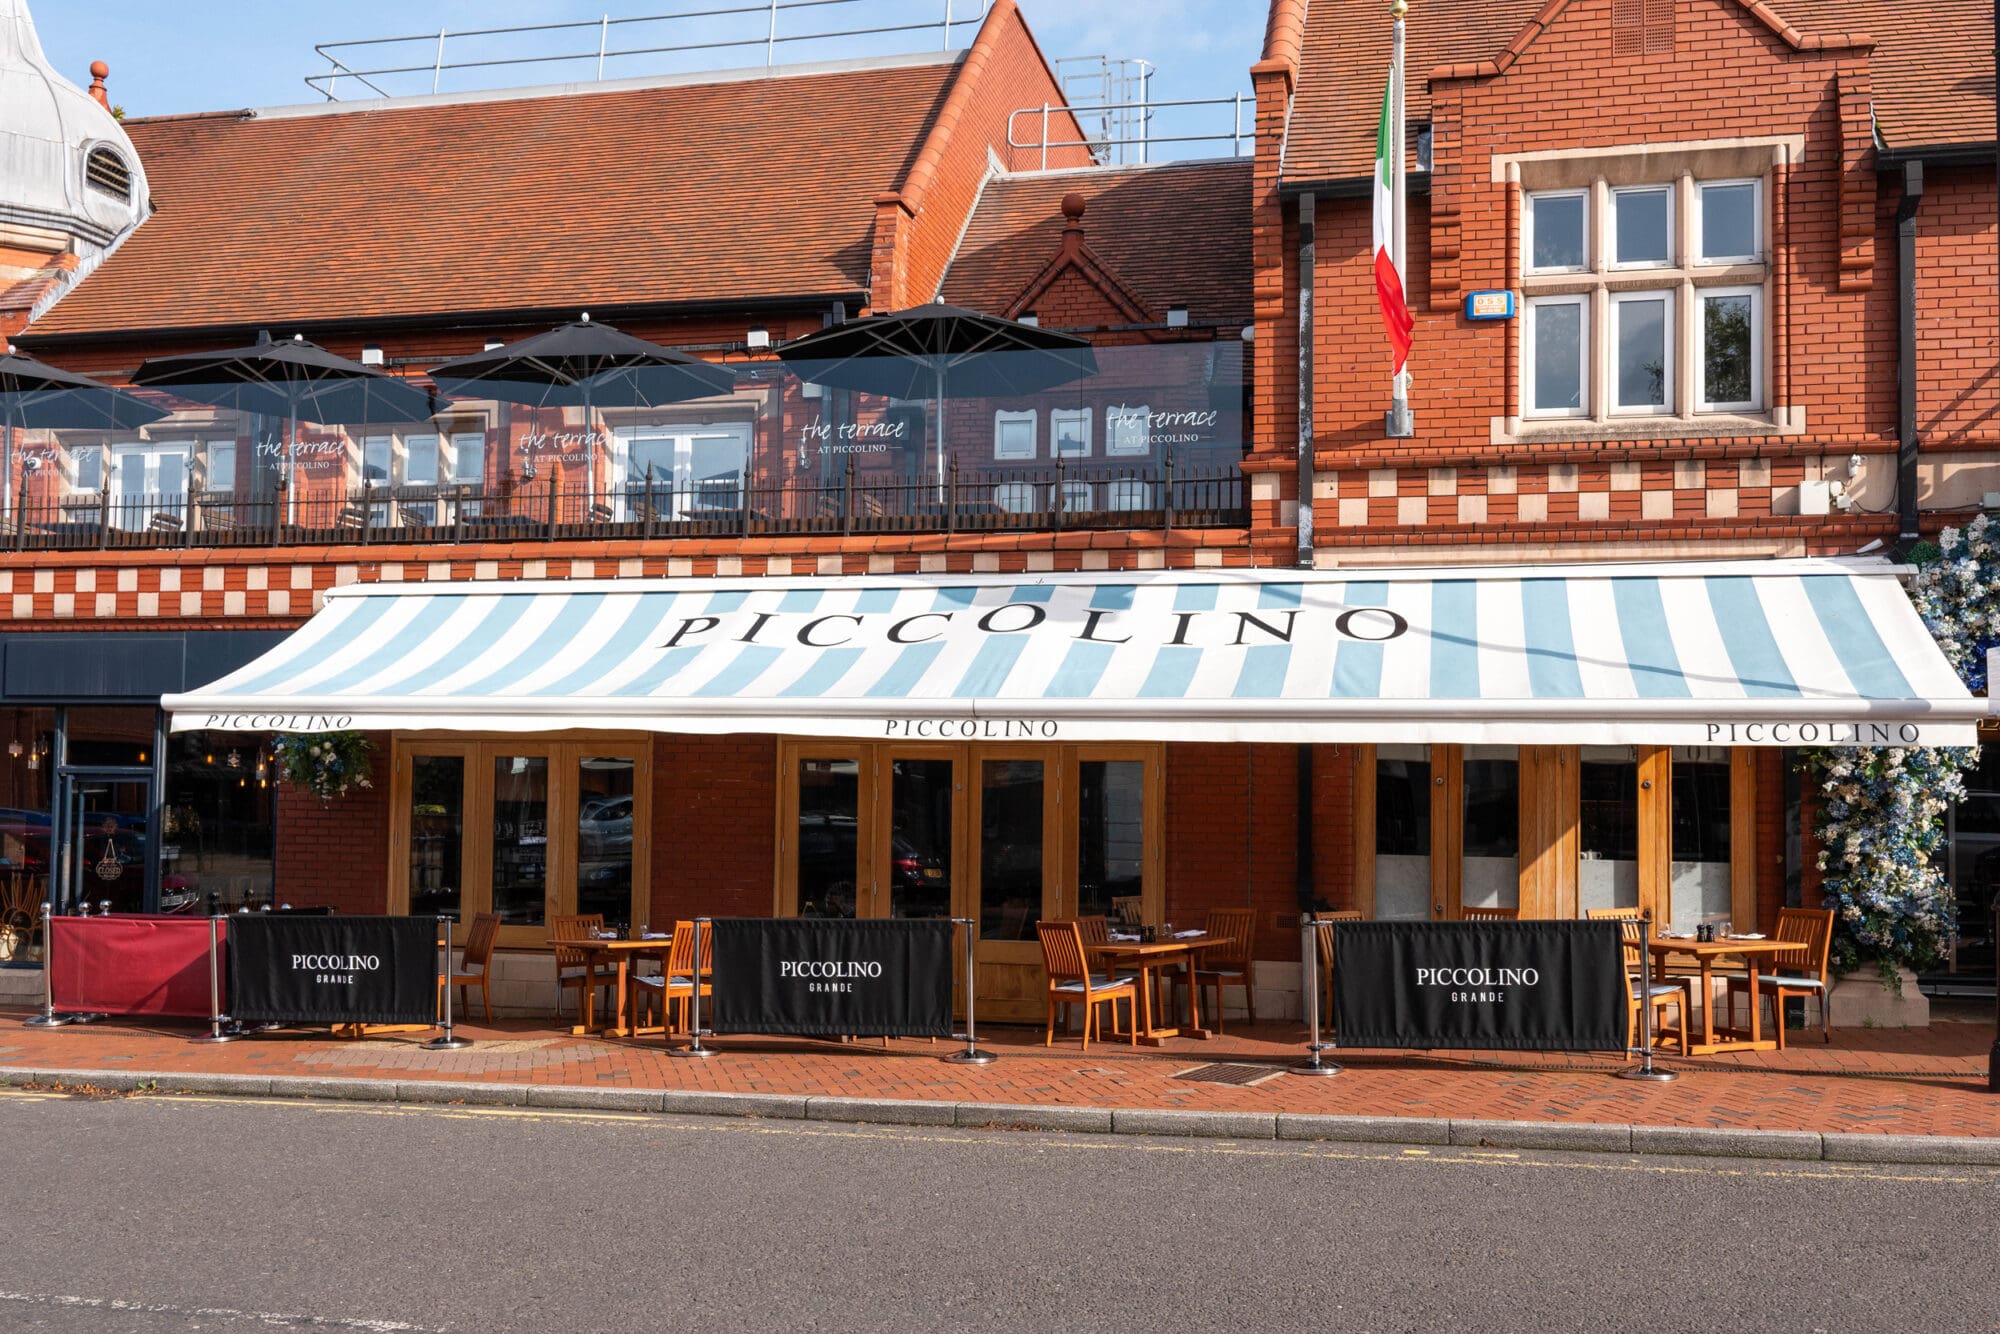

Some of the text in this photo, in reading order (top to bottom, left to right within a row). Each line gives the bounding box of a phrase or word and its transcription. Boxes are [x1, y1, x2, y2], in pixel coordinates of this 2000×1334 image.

[1107, 403, 1217, 429] the terrace
[519, 423, 614, 449] the terrac
[801, 414, 904, 444] the terrace
[256, 433, 344, 457] the terrace
[1141, 434, 1199, 443] PICCOLINO
[11, 442, 35, 465] the
[817, 444, 887, 454] AT PICCOLINO
[548, 453, 598, 462] PICCOLINO
[656, 604, 1409, 647] PICCOLINO
[204, 714, 352, 730] PICCOLINO
[885, 720, 1058, 737] PICCOLINO
[1706, 723, 1920, 742] PICCOLINO
[292, 955, 380, 970] PICCOLINO
[780, 961, 882, 977] PICCOLINO
[316, 974, 354, 984] GRANDE
[1416, 968, 1539, 985] PICCOLINO
[809, 982, 852, 992] GRANDE
[1451, 992, 1504, 1002] GRANDE
